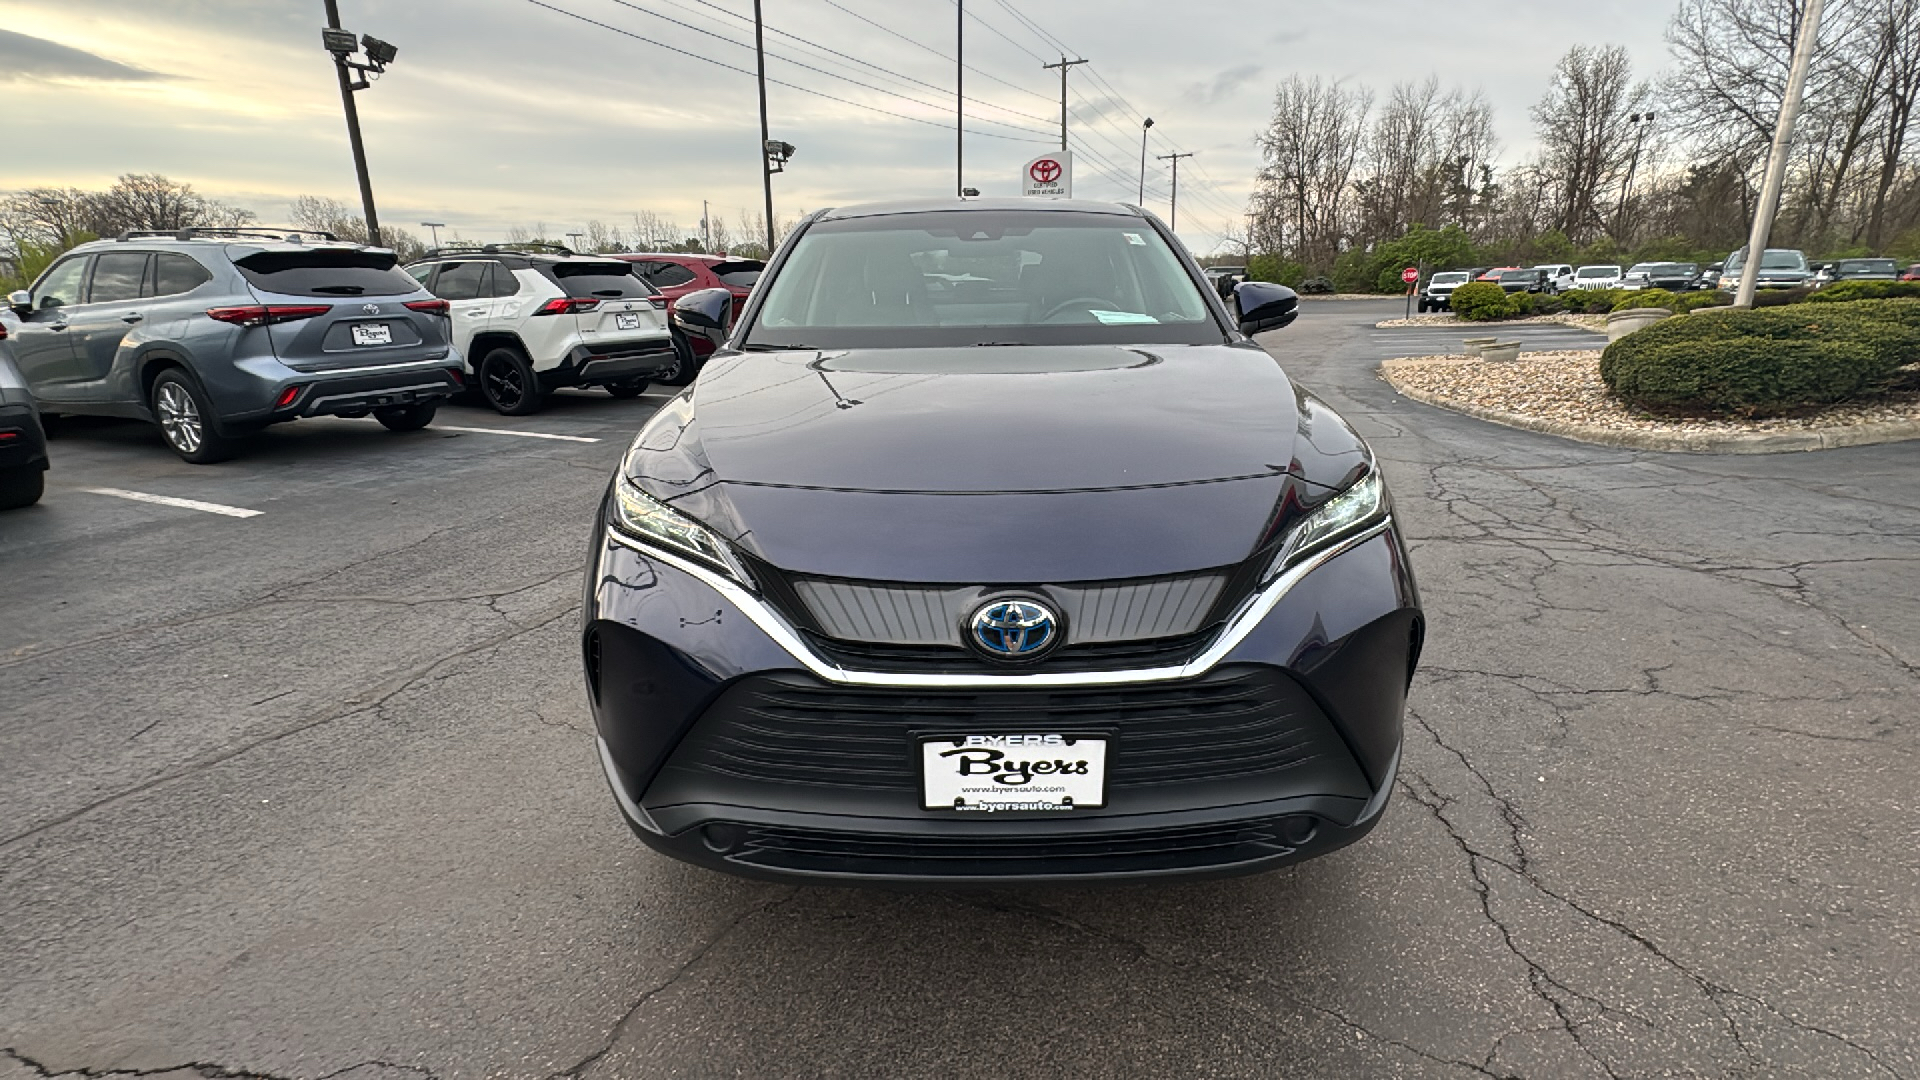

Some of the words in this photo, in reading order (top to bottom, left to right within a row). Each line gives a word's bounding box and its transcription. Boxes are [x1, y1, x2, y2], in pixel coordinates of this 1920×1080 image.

[1403, 271, 1418, 279] STOP
[966, 735, 1063, 747] BYERS
[939, 748, 1088, 785] Byers
[961, 785, 1066, 794] www.byersauto.com
[956, 800, 1073, 812] www.byersauto.com
